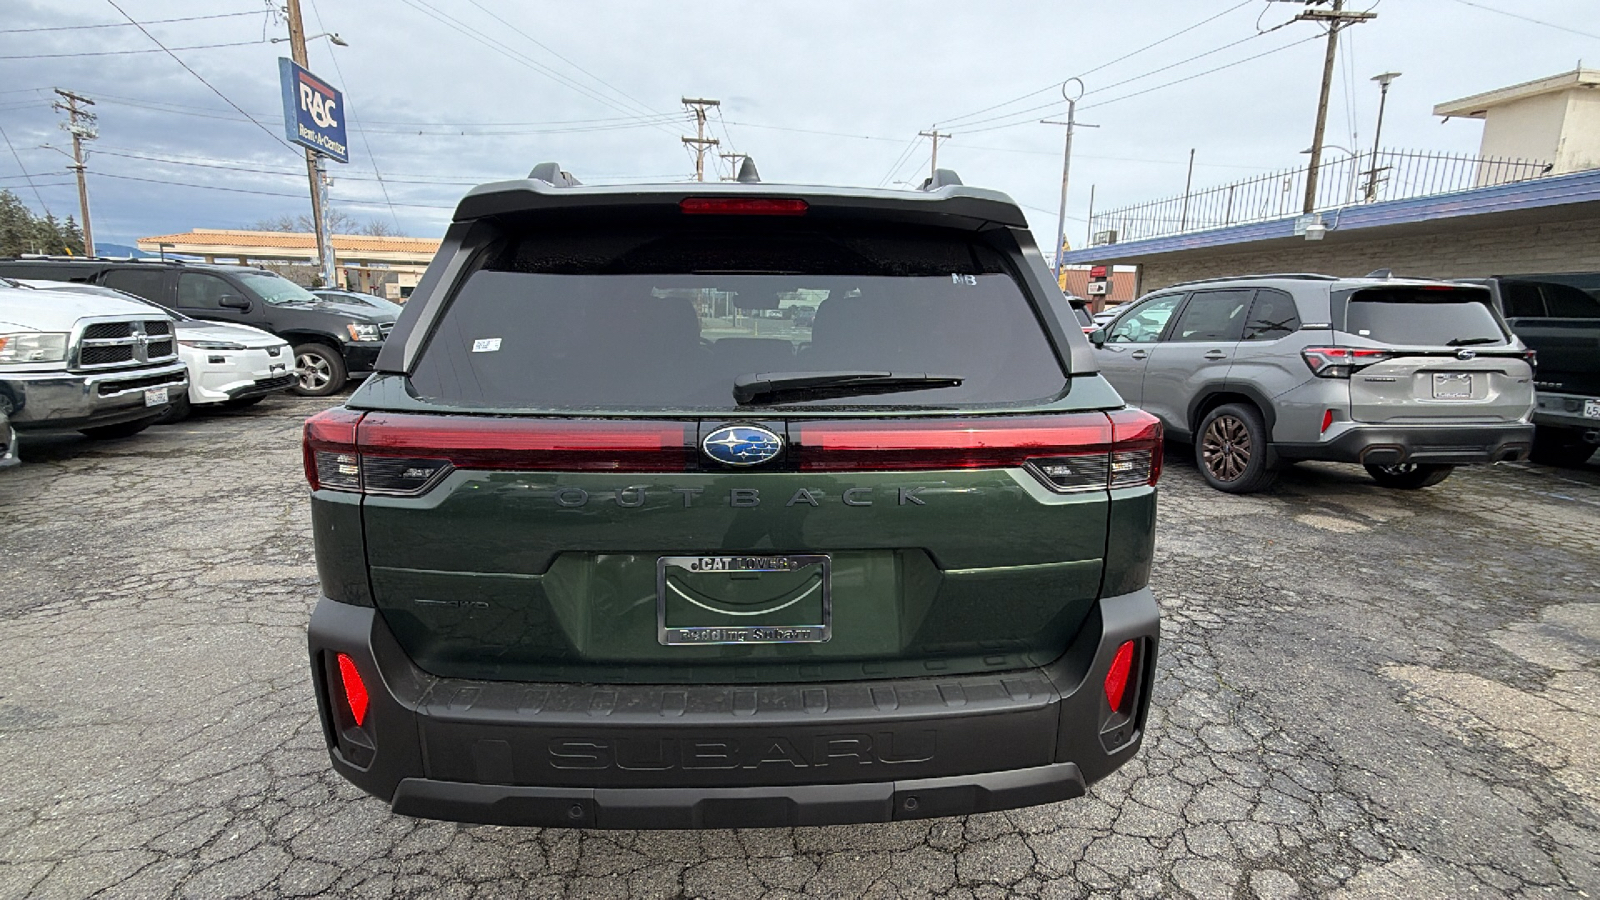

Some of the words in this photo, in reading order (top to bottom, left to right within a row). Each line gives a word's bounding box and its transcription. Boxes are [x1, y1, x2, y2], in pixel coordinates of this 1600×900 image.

[299, 81, 337, 128] RAC
[554, 486, 927, 509] OUTBACK
[701, 557, 733, 571] CAT
[679, 629, 748, 642] Redding
[752, 628, 811, 640] Subaru
[548, 729, 938, 771] SUBARU
